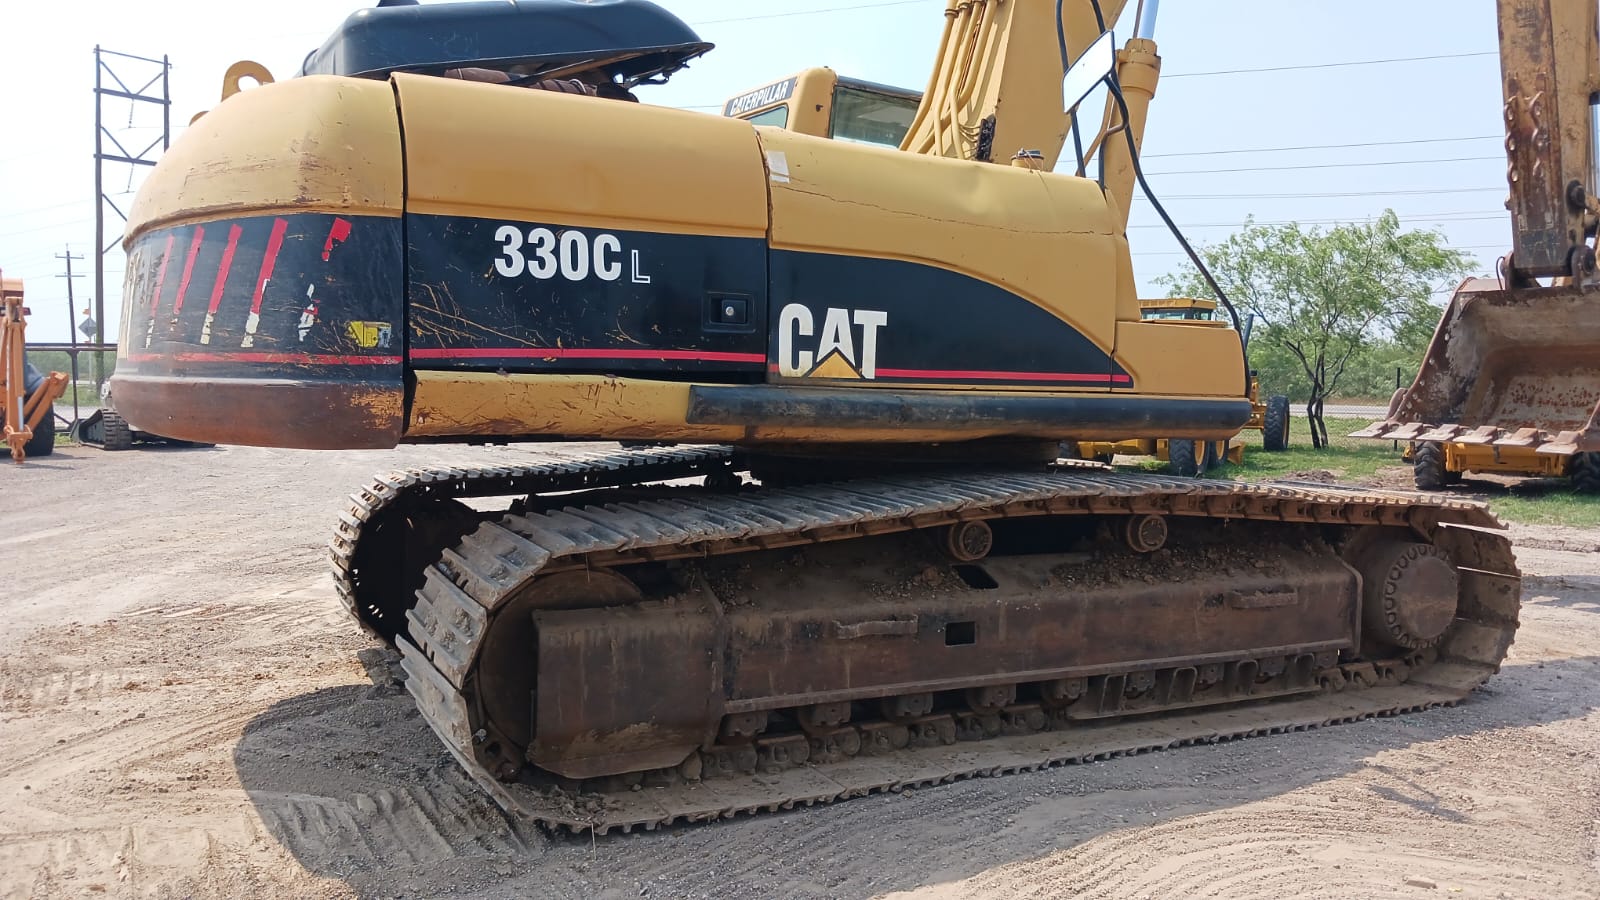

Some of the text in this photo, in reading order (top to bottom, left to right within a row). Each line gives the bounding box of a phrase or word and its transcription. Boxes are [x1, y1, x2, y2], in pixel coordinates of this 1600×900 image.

[729, 80, 789, 116] CATERPILLAR
[494, 225, 650, 284] 330C L
[778, 303, 888, 379] CAT
